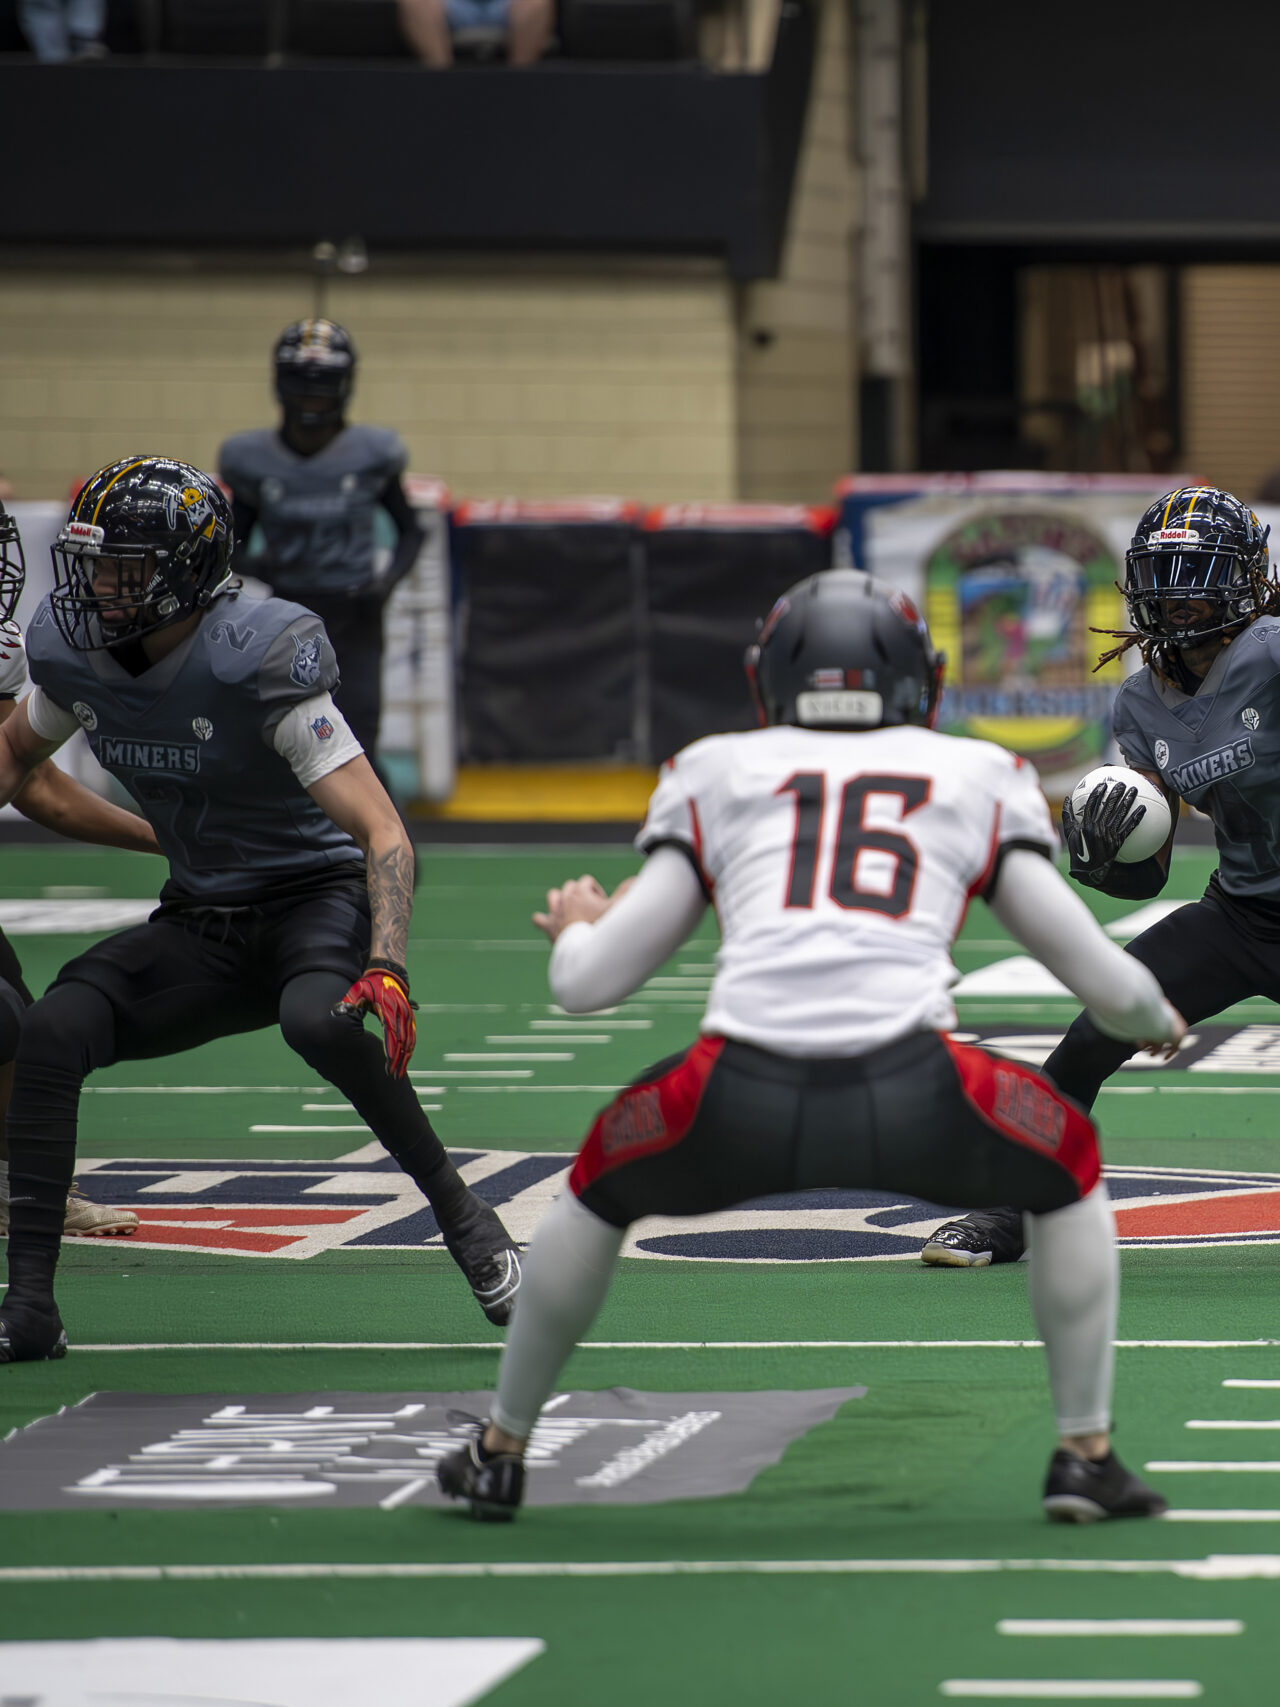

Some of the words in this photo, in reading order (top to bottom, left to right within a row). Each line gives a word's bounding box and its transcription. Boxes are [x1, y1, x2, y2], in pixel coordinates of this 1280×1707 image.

[1160, 531, 1187, 539] Riddell
[210, 620, 257, 653] 2
[102, 741, 199, 772] MINERS
[1173, 742, 1252, 792] MINERS
[773, 771, 933, 919] 16
